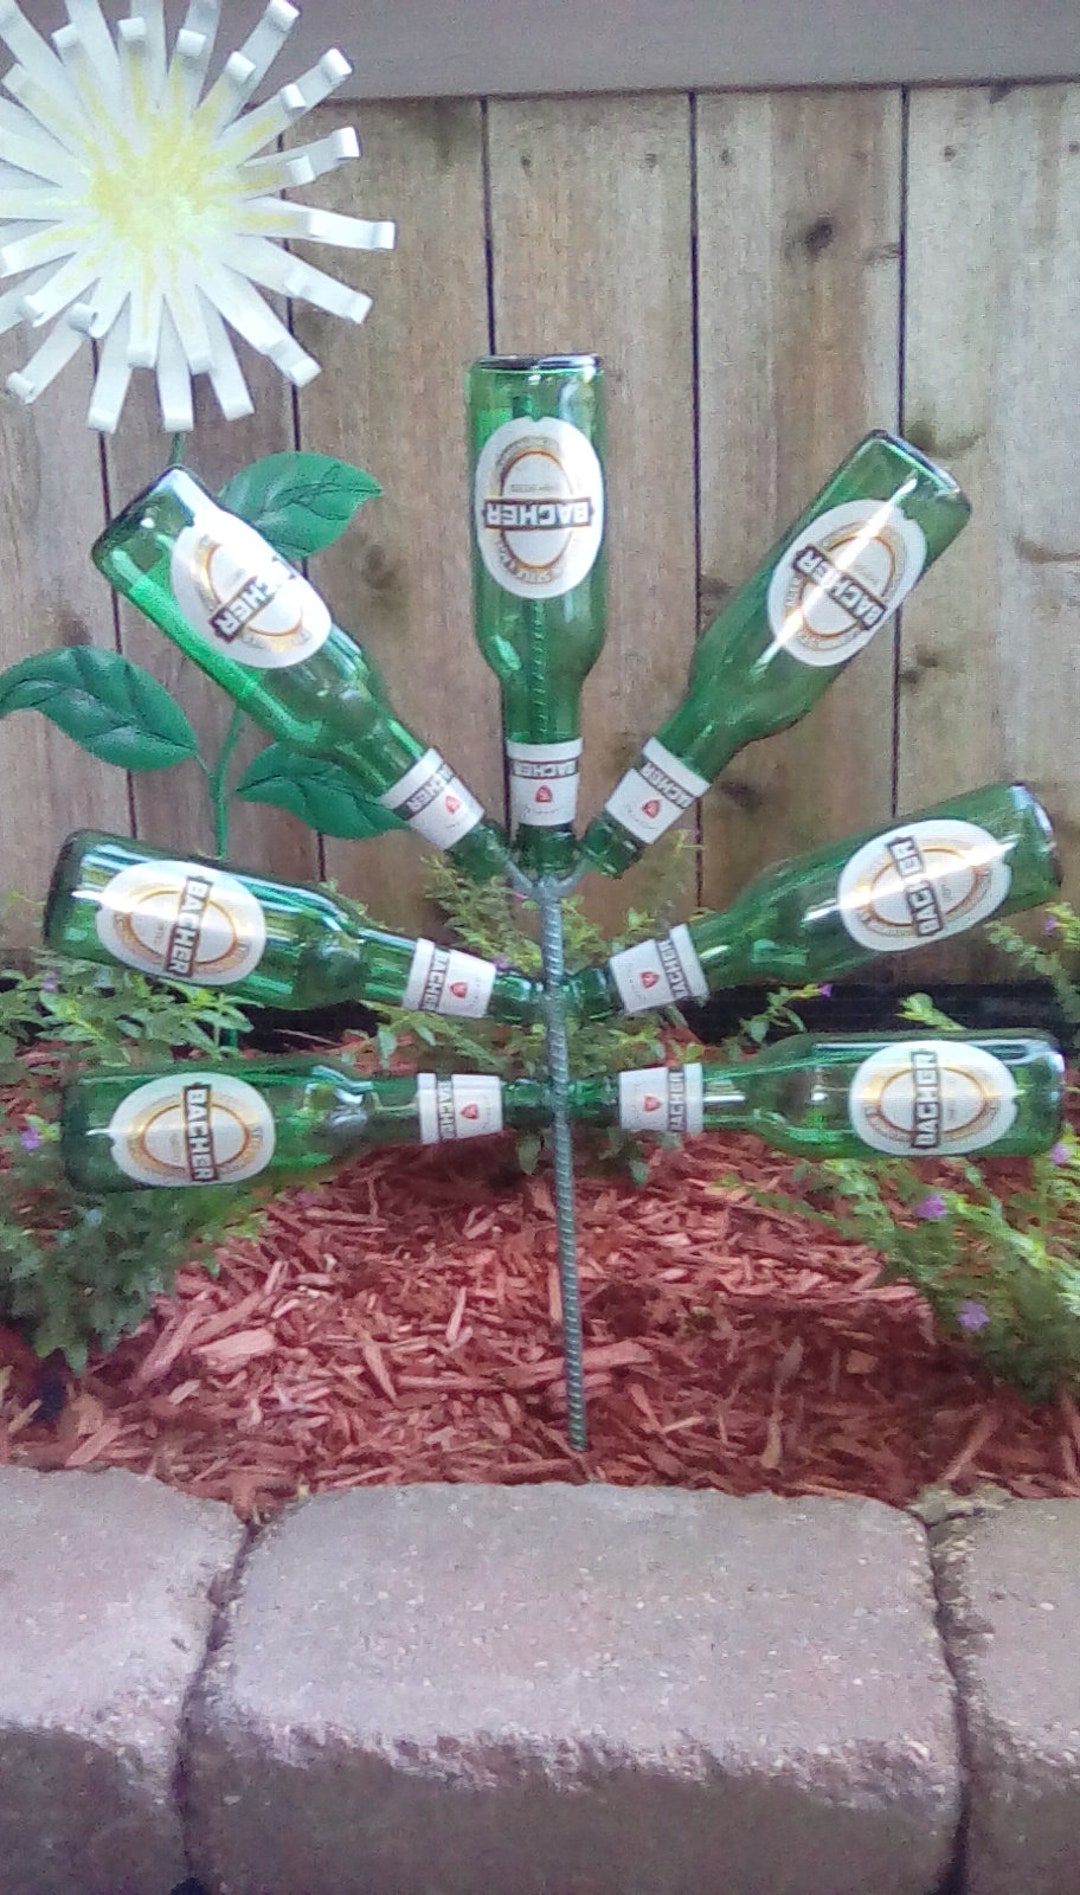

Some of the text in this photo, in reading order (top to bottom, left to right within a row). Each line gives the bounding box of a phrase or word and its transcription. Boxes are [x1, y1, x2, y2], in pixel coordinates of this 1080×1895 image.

[486, 500, 589, 526] BACHER
[797, 550, 885, 628] BACHER
[406, 764, 453, 813] ACHER
[513, 760, 577, 778] BACHER
[168, 879, 211, 973] BACHER
[186, 1088, 214, 1181] BACHER
[914, 1052, 939, 1146] BACHER
